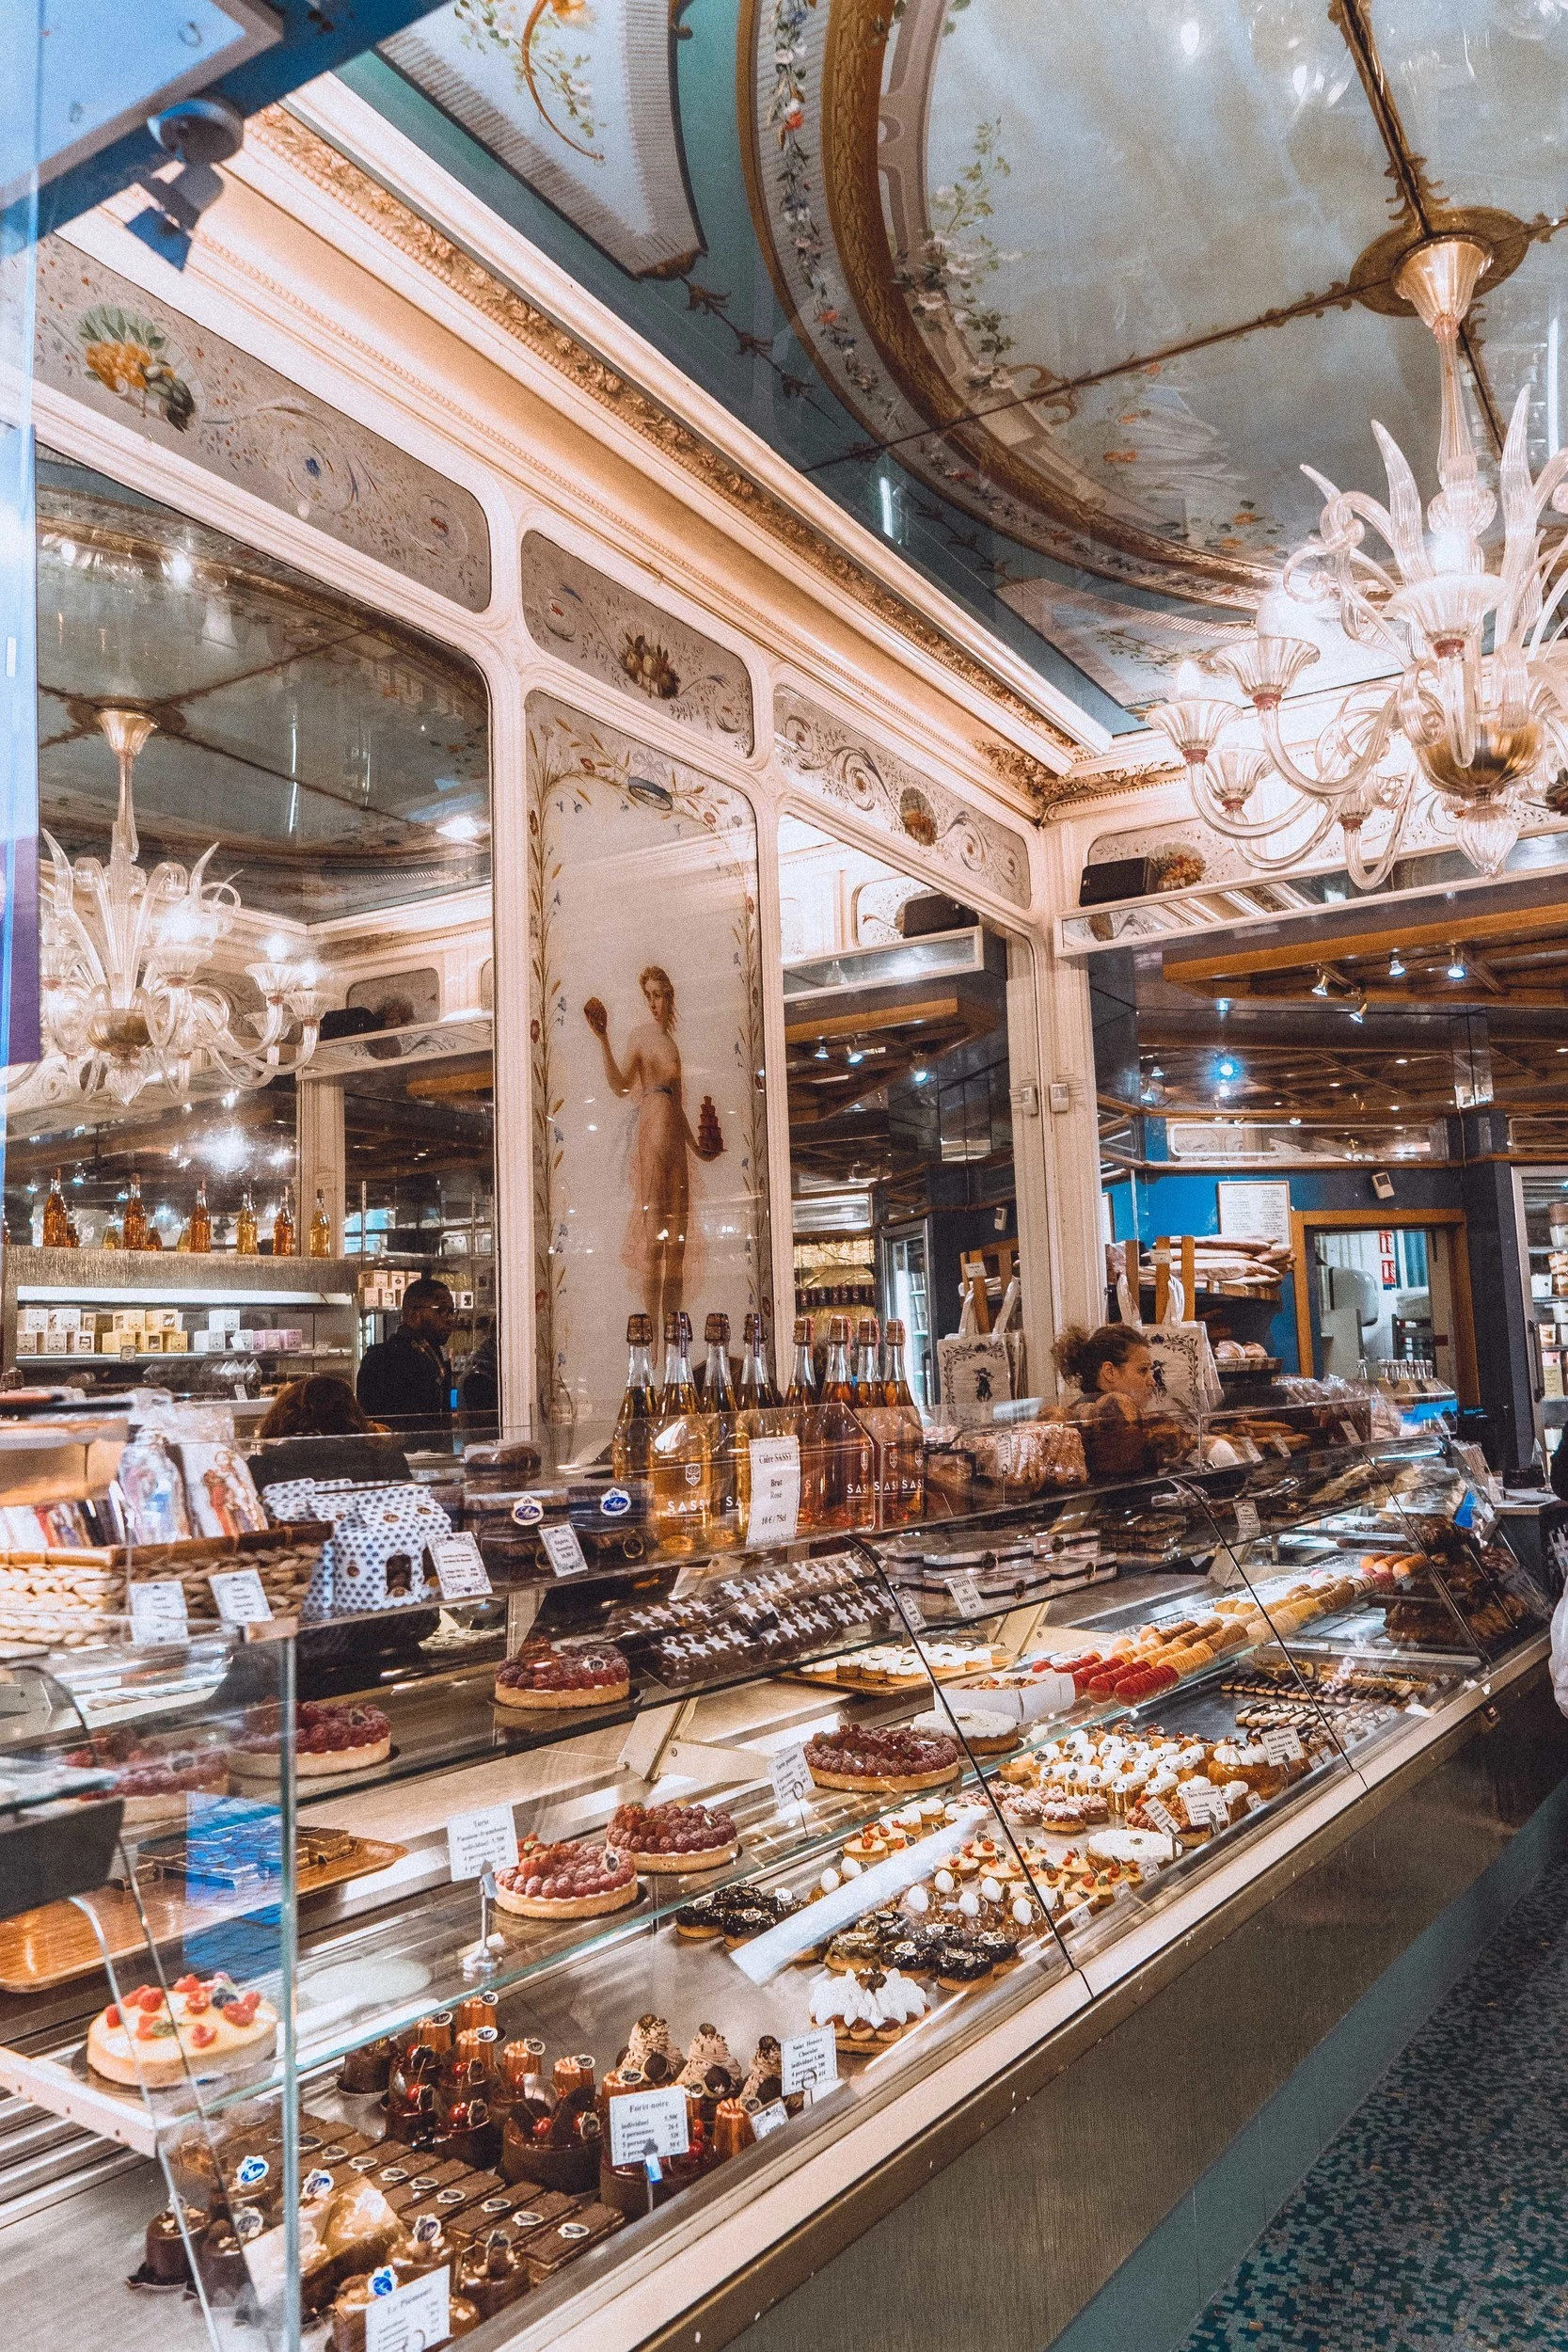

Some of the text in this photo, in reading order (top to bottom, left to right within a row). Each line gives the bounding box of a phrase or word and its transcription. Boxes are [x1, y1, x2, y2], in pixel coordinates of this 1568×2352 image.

[774, 1453, 792, 1461] SASSY
[622, 2120, 649, 2129] individuel
[627, 2129, 654, 2138] personnes
